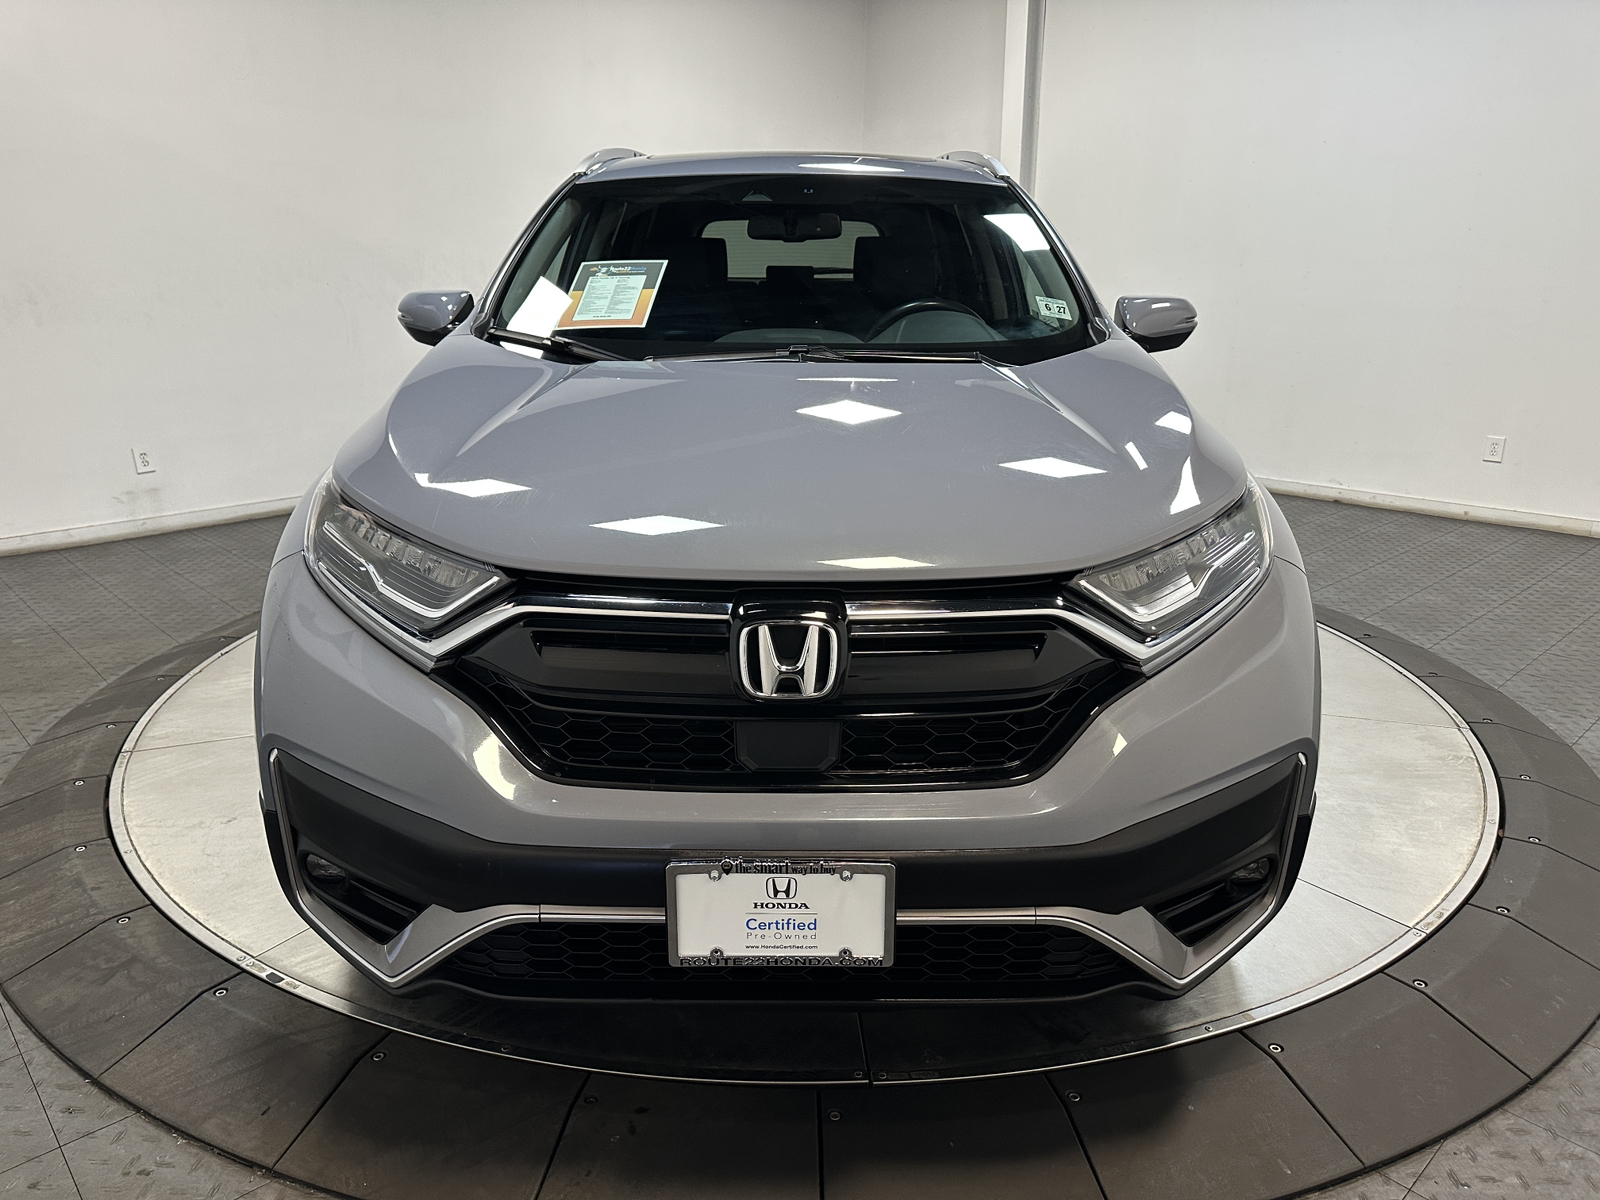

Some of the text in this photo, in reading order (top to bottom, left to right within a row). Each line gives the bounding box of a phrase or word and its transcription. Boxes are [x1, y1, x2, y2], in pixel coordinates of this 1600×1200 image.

[1045, 304, 1066, 314] 6 27
[735, 860, 837, 876] the smart way to buy
[745, 918, 817, 930] Certified
[746, 932, 817, 940] Pre-Owned
[679, 956, 884, 967] ROUTE22HONDA.COM
